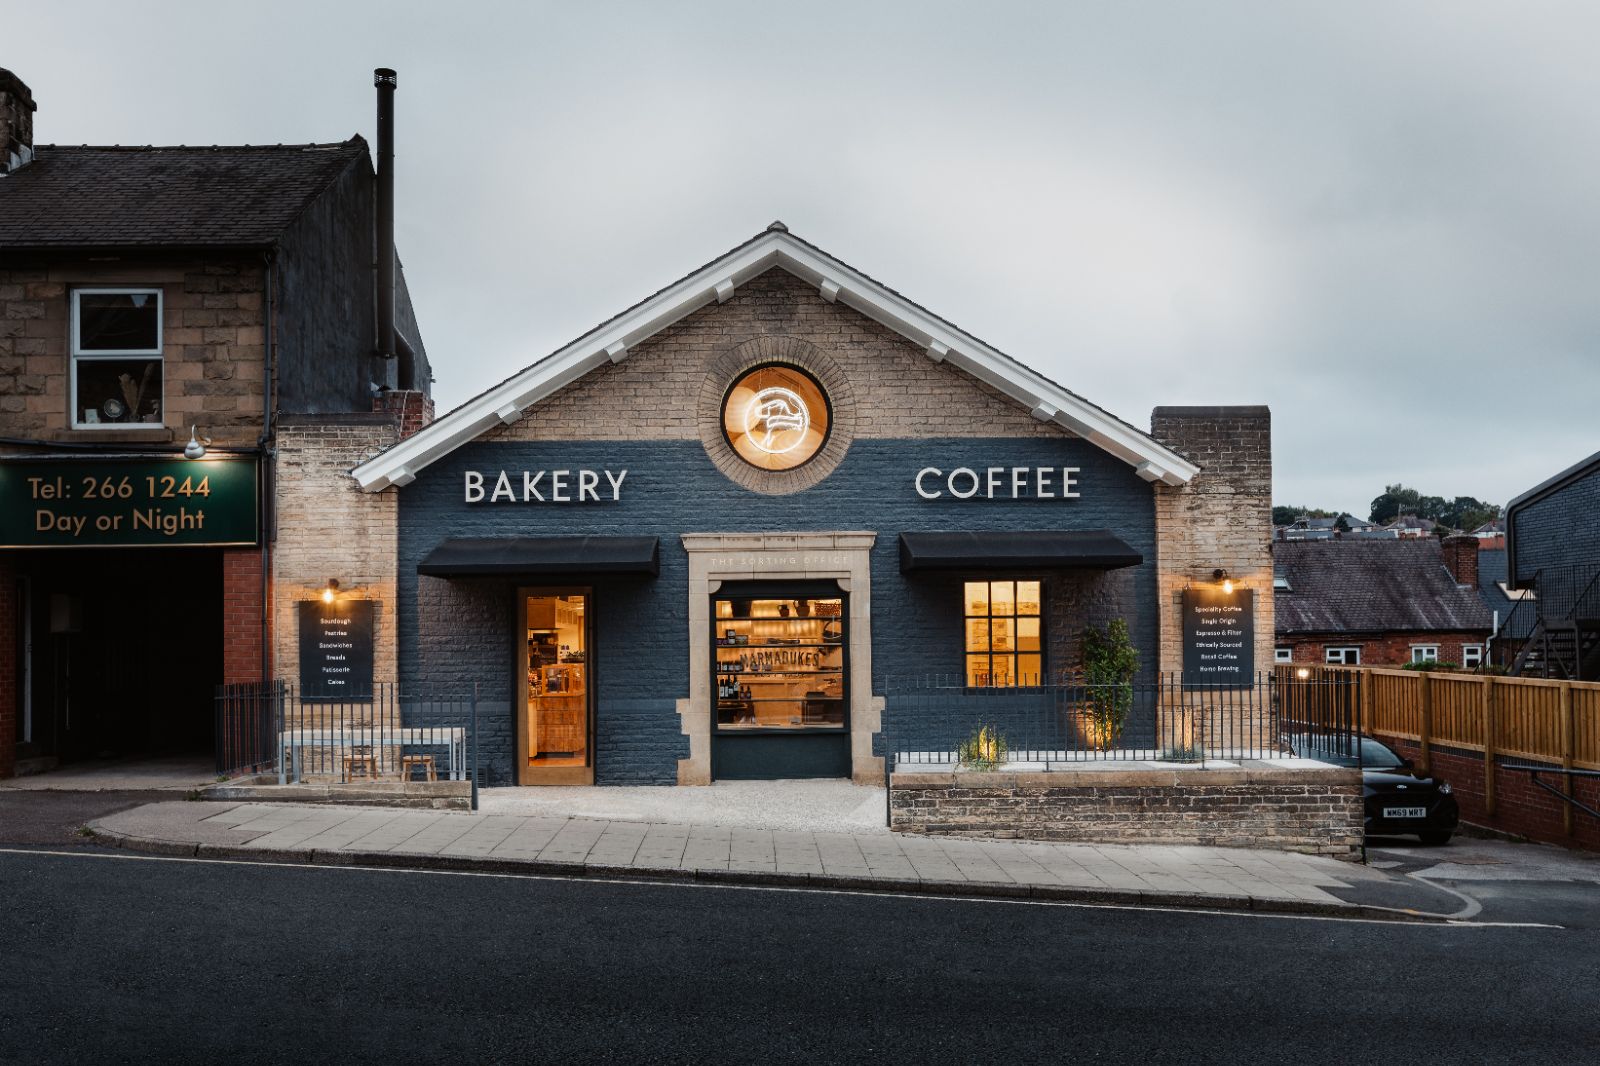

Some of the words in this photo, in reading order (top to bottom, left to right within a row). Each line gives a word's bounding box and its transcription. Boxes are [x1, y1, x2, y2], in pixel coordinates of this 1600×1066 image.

[27, 476, 71, 499] Tel:
[82, 476, 133, 499] 266
[146, 475, 211, 498] 1244
[465, 469, 628, 502] BAKERY
[915, 466, 1081, 499] COFFEE
[36, 509, 87, 536] Day
[95, 514, 123, 531] or
[133, 507, 204, 535] Night
[711, 558, 733, 566] THE
[740, 557, 796, 565] SORTING
[803, 556, 849, 564] OFFICE
[739, 650, 820, 667] MARMADUKES
